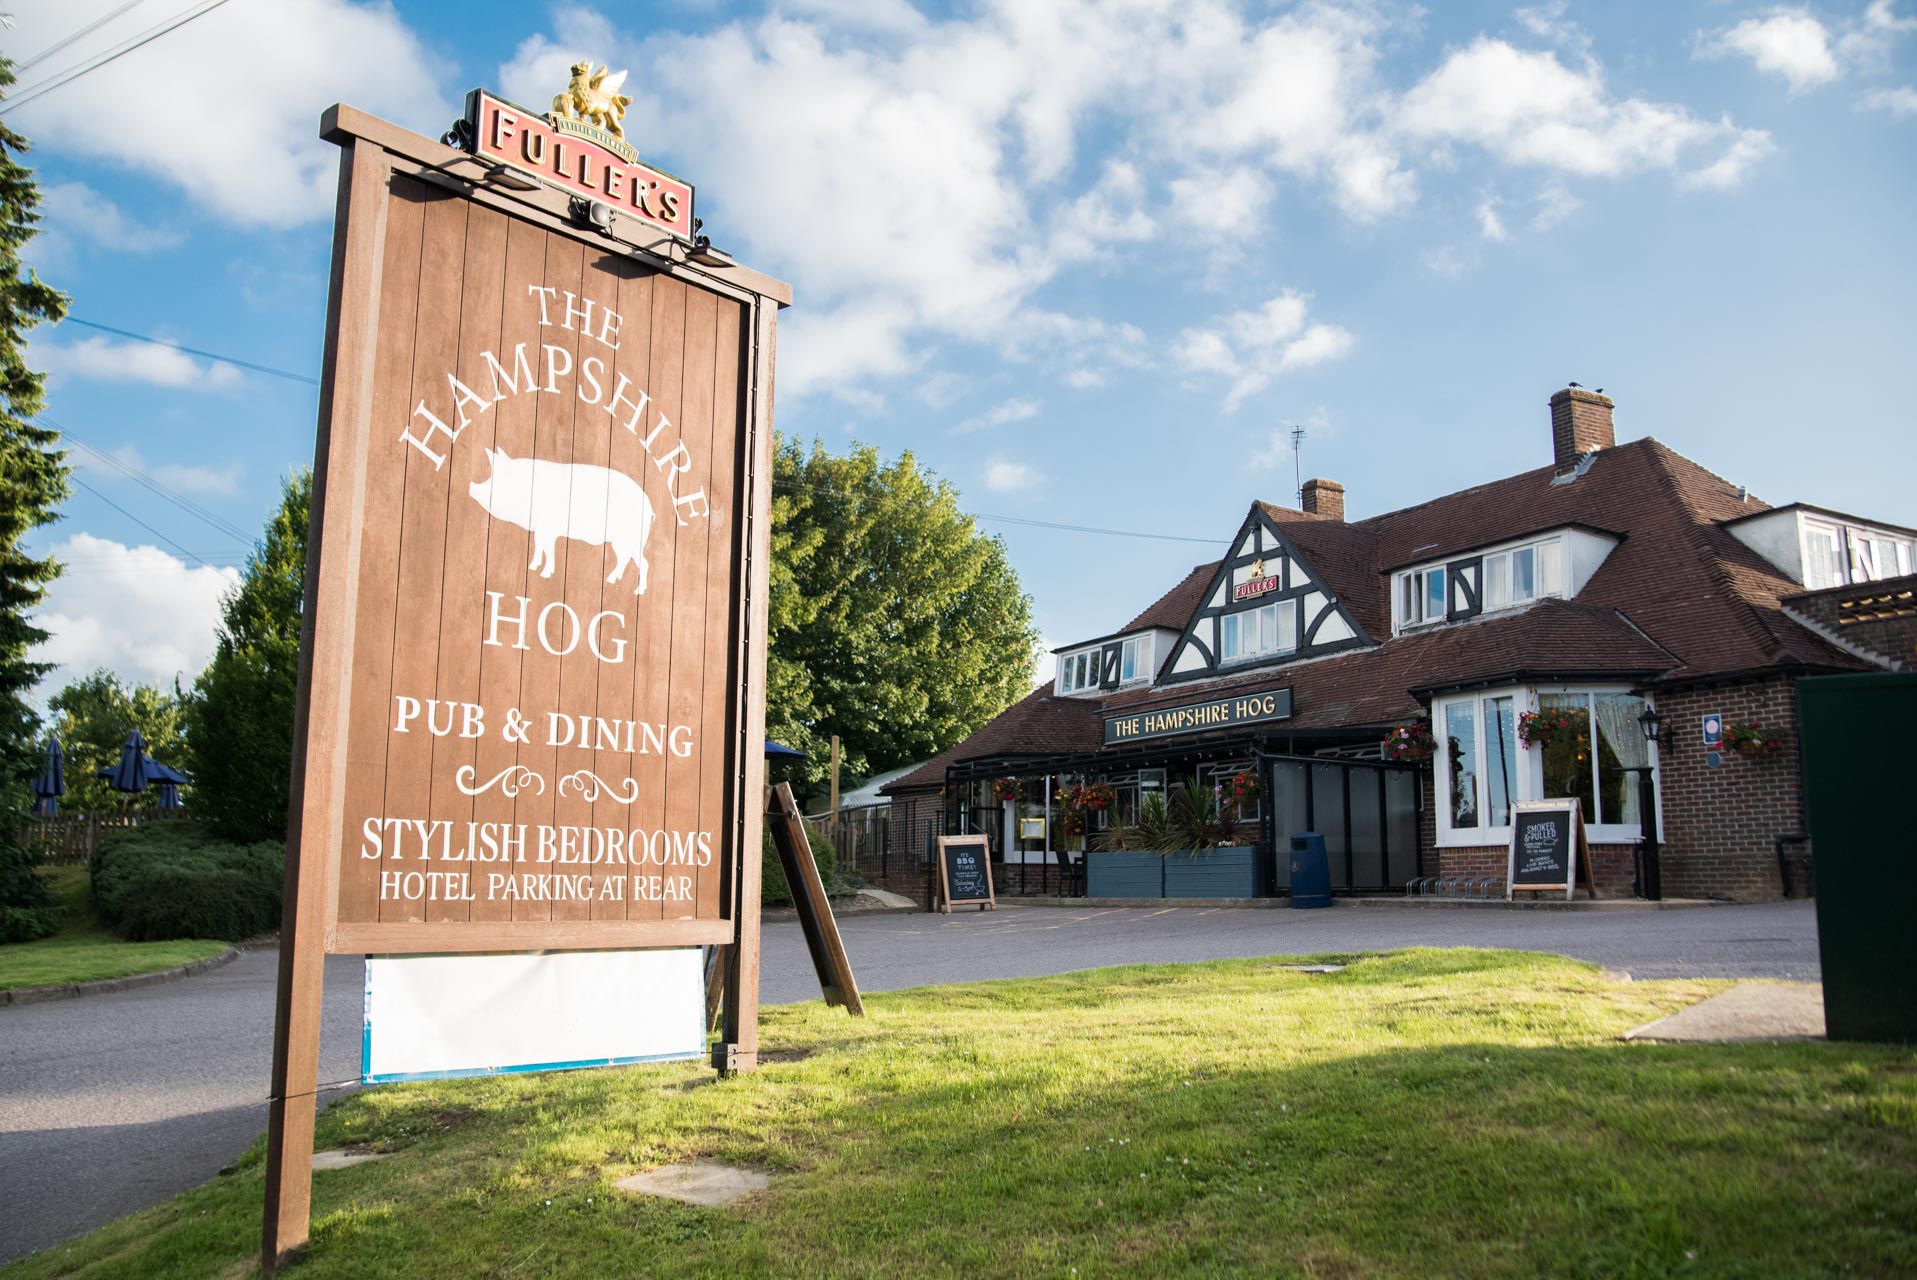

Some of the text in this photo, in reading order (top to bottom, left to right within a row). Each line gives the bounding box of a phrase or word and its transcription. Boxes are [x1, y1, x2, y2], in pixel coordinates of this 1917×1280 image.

[493, 108, 681, 223] FULLER'S
[528, 284, 625, 351] THE
[398, 342, 710, 527] HAMPSHIRE
[483, 590, 628, 664] HOG
[393, 695, 695, 758] PUB & DINING
[1114, 695, 1277, 737] THE HAMPSHIRE HOG
[361, 816, 712, 867] STYLISH BEDROOMS
[1527, 821, 1555, 834] SMOKED
[379, 871, 694, 901] HOTEL PARKING AT REAR
